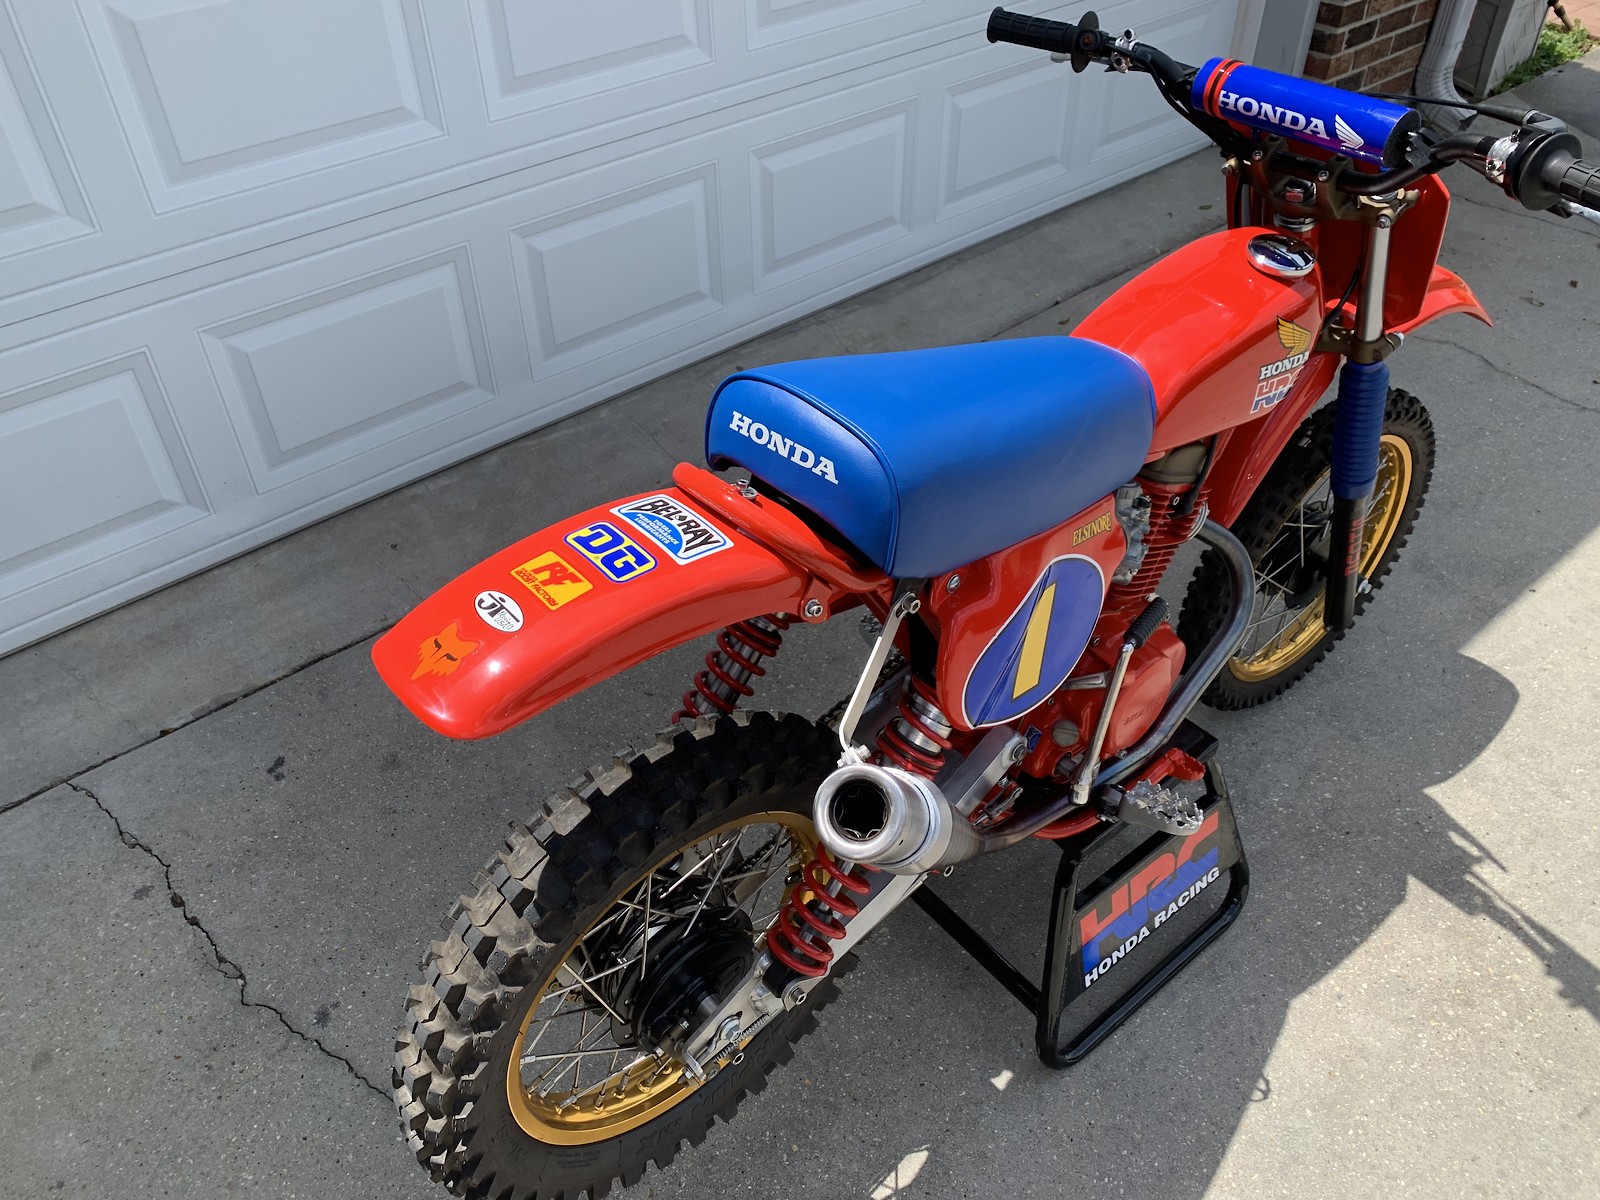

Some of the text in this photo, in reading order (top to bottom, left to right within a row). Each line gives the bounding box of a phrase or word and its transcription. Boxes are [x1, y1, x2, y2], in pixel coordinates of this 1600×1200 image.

[1218, 90, 1330, 140] HONDA
[1259, 351, 1310, 381] HONDA
[729, 410, 839, 485] HONDA
[634, 518, 671, 544] LUBRICANTS
[636, 513, 679, 545] PERFORMANCE
[653, 519, 672, 534] TOTAL
[1072, 511, 1112, 547] ELSINORE
[572, 524, 652, 579] DG
[514, 569, 534, 585] ROOST
[531, 581, 559, 607] FACTORY
[1080, 811, 1219, 973] HRC
[1084, 866, 1220, 988] HONDA RACING
